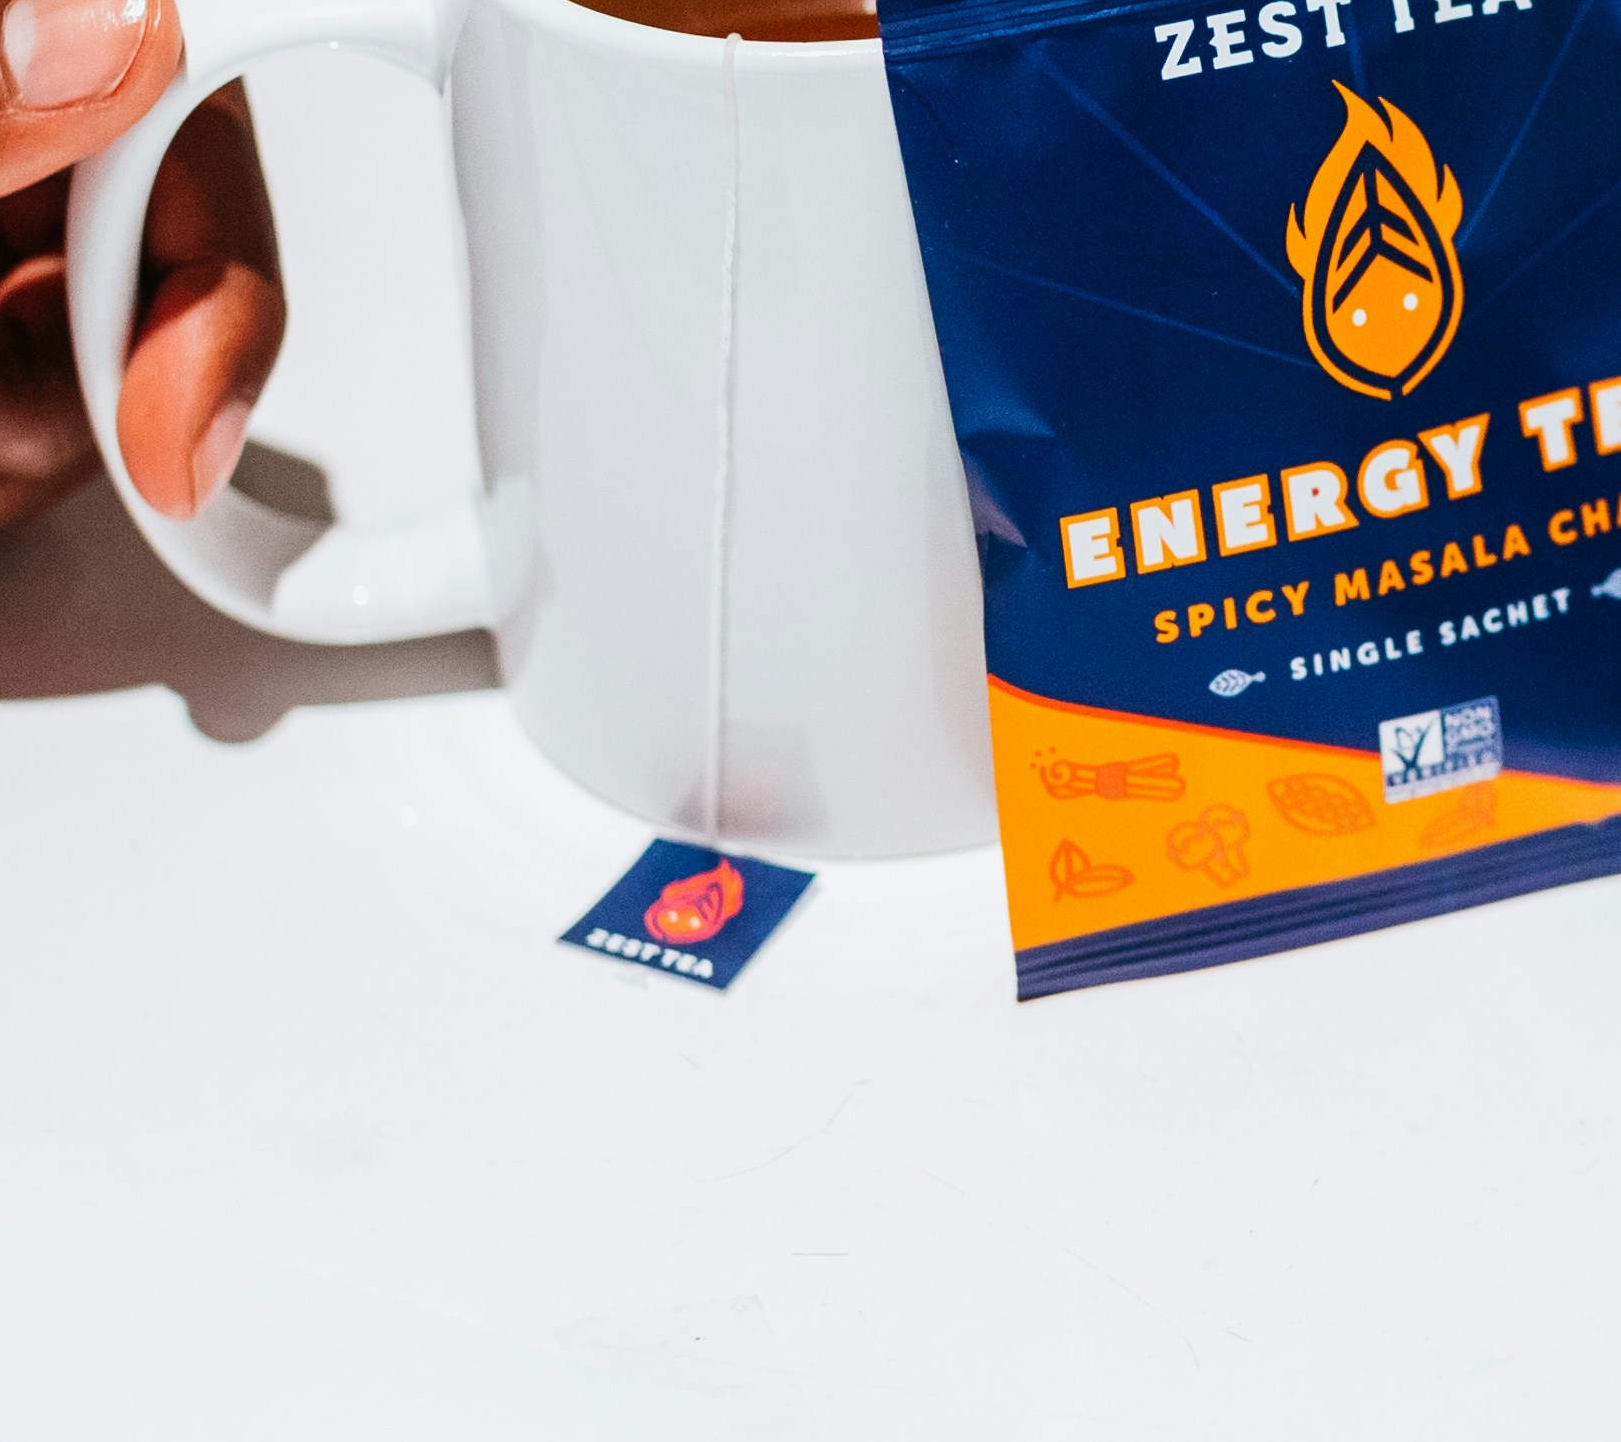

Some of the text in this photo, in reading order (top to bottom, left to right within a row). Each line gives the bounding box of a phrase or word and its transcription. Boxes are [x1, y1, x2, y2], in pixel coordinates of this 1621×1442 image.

[1059, 413, 1491, 590] ENERGY
[1153, 581, 1311, 645] SPICY
[1334, 523, 1532, 607] MASALA
[1289, 587, 1573, 682] SINGLE SACHET
